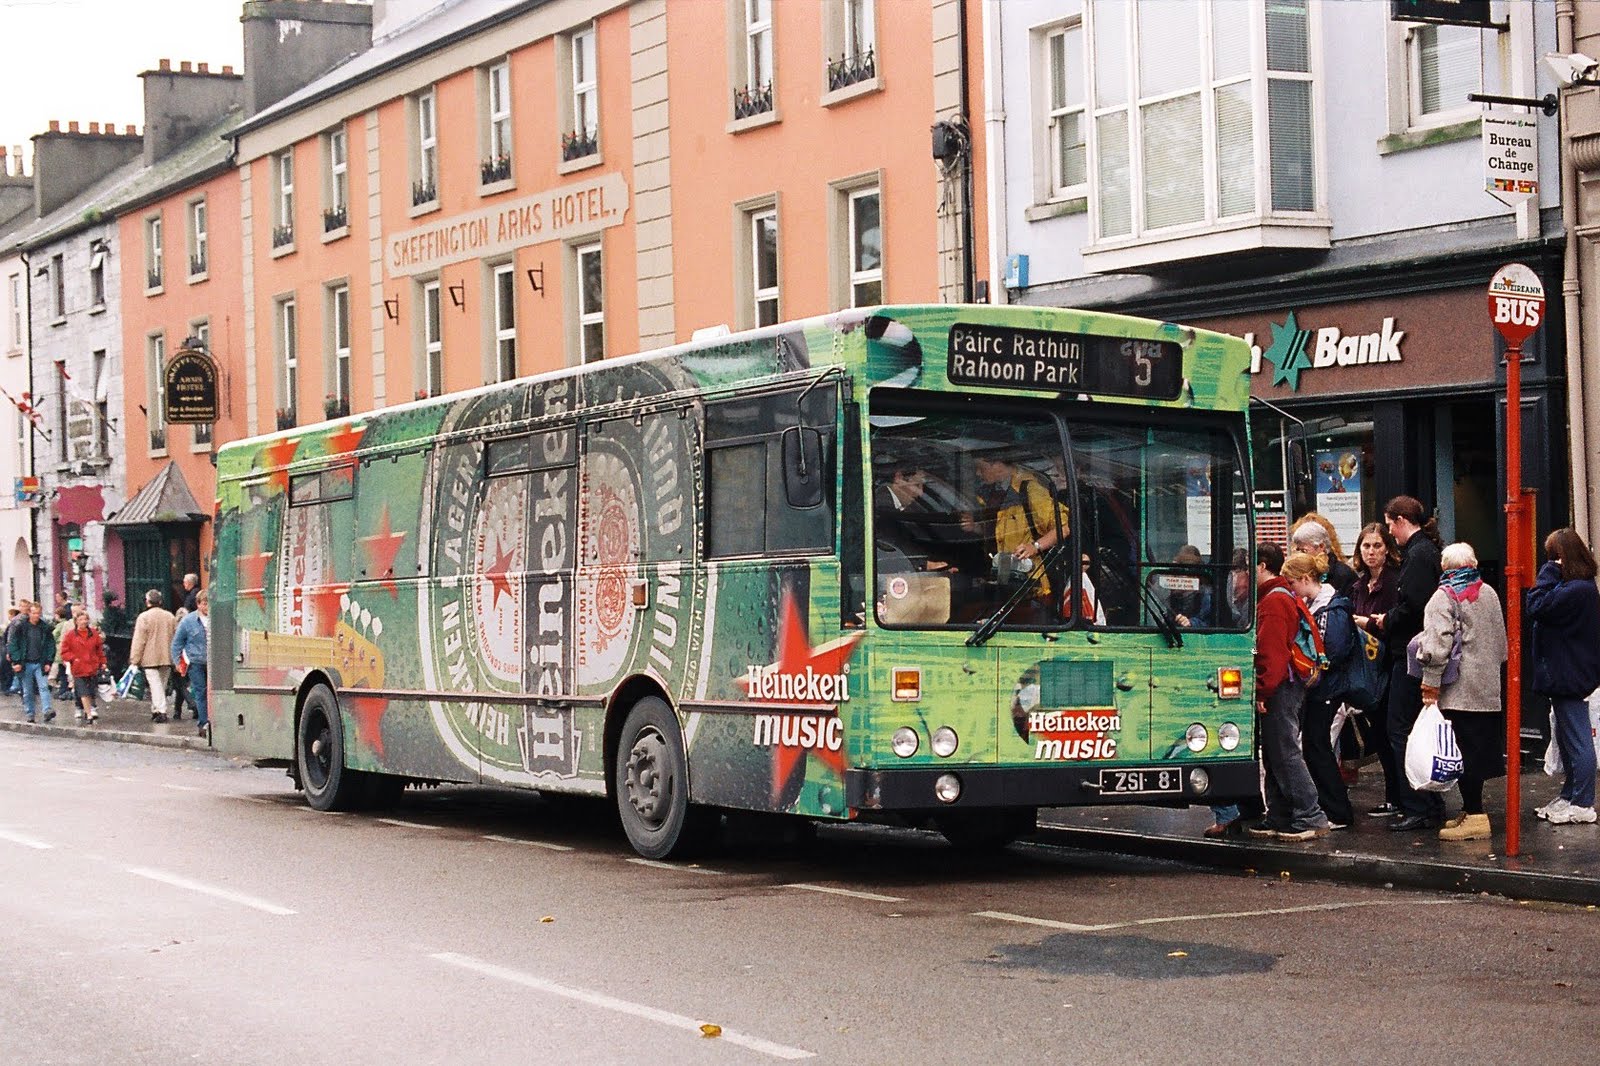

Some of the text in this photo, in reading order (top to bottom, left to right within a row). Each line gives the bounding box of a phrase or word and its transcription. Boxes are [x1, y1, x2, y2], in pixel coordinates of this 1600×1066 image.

[1490, 133, 1531, 147] Bureau
[1505, 148, 1517, 158] de
[1488, 157, 1534, 173] Change
[393, 217, 489, 267] SKEFFINGTON
[497, 202, 541, 243] ARMS
[1495, 297, 1540, 327] BUS
[954, 331, 1080, 360] Páirc Rathún
[1313, 317, 1405, 368] Bank
[952, 354, 1078, 384] Rahoon Park
[1135, 350, 1152, 386] 5
[441, 453, 477, 588] LAGER
[531, 380, 570, 762] Heineken
[579, 588, 587, 666] DIPLOME
[692, 610, 702, 652] WITH
[747, 665, 850, 701] Heineken
[753, 714, 844, 751] music
[1029, 712, 1121, 732] Heineken
[1034, 732, 1117, 760] music
[1115, 771, 1171, 791] ZSI 8
